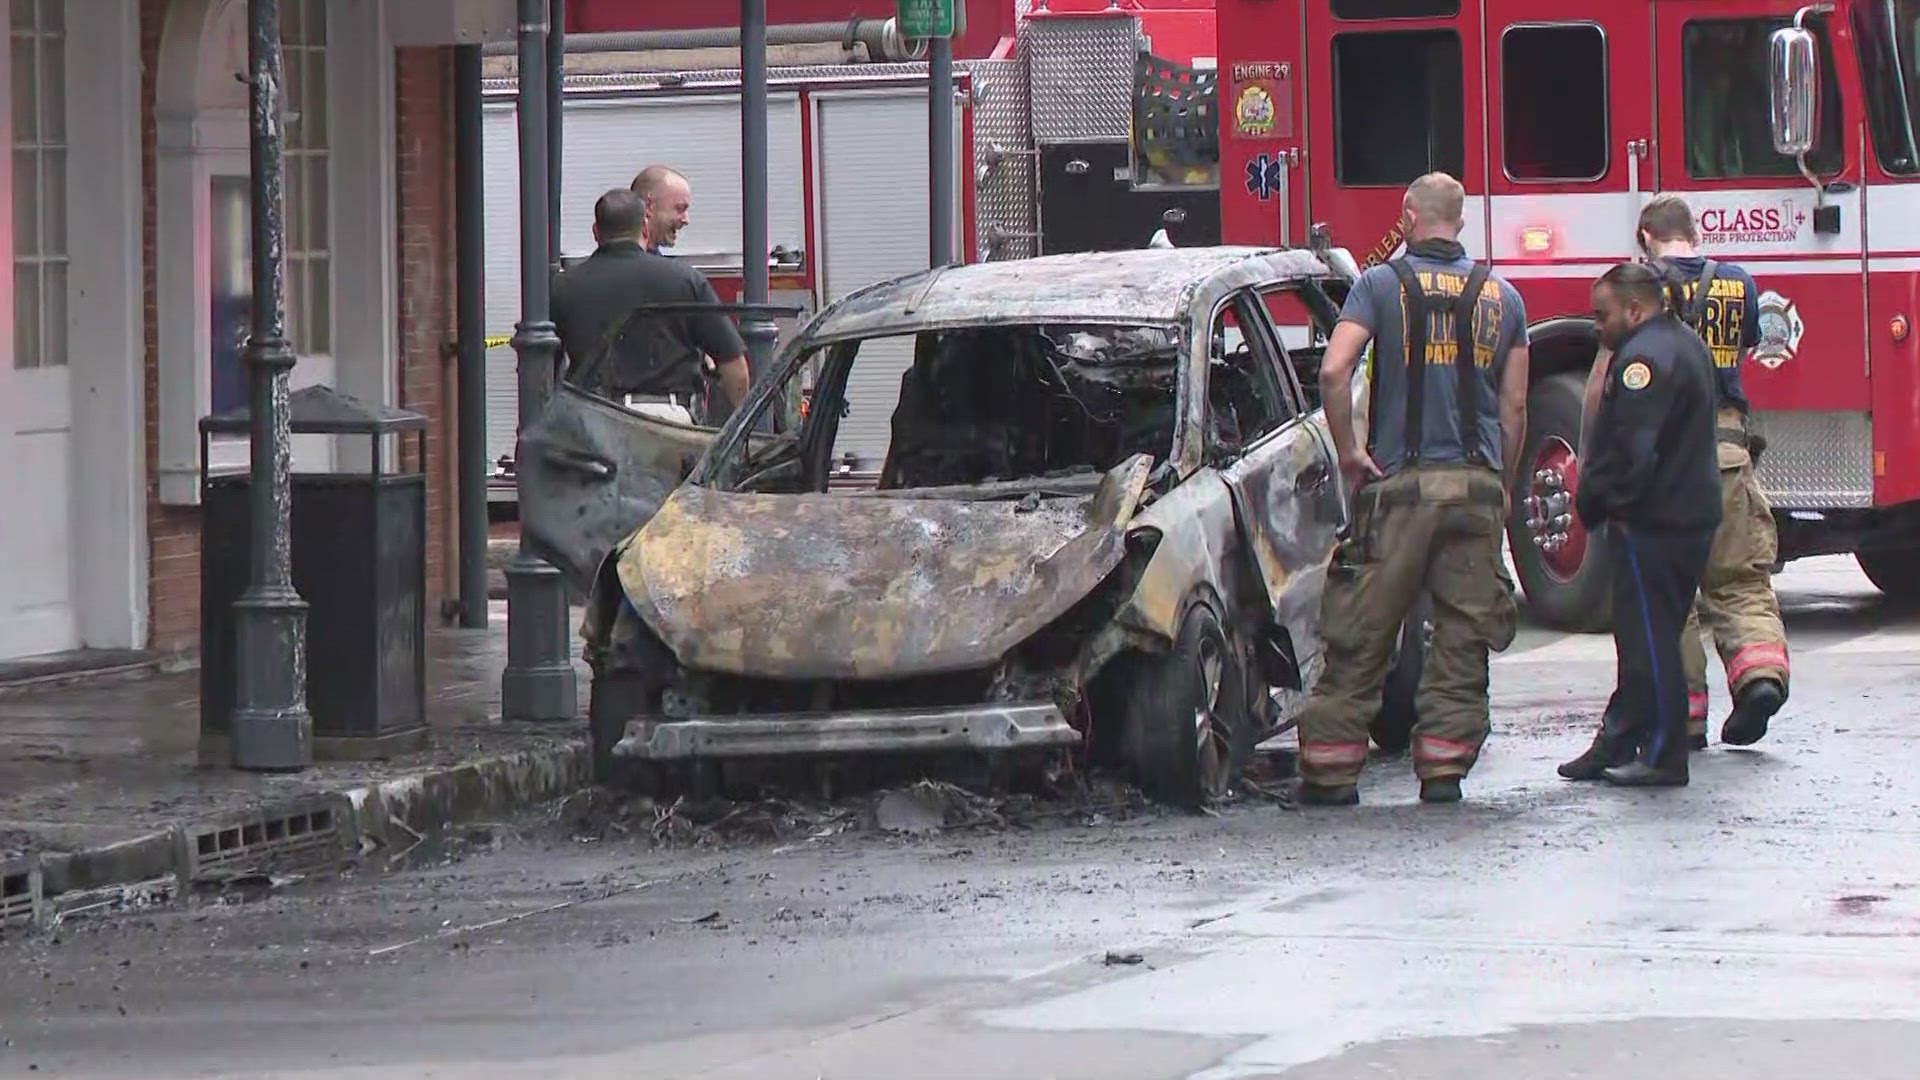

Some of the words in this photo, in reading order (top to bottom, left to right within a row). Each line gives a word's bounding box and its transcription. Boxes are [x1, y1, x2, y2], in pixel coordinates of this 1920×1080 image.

[1234, 63, 1271, 82] ENGINE
[1273, 64, 1289, 80] 29
[1701, 208, 1780, 232] CLASS
[1782, 197, 1799, 232] 1
[1702, 233, 1727, 244] FIRE
[1729, 230, 1797, 243] PROTECTION
